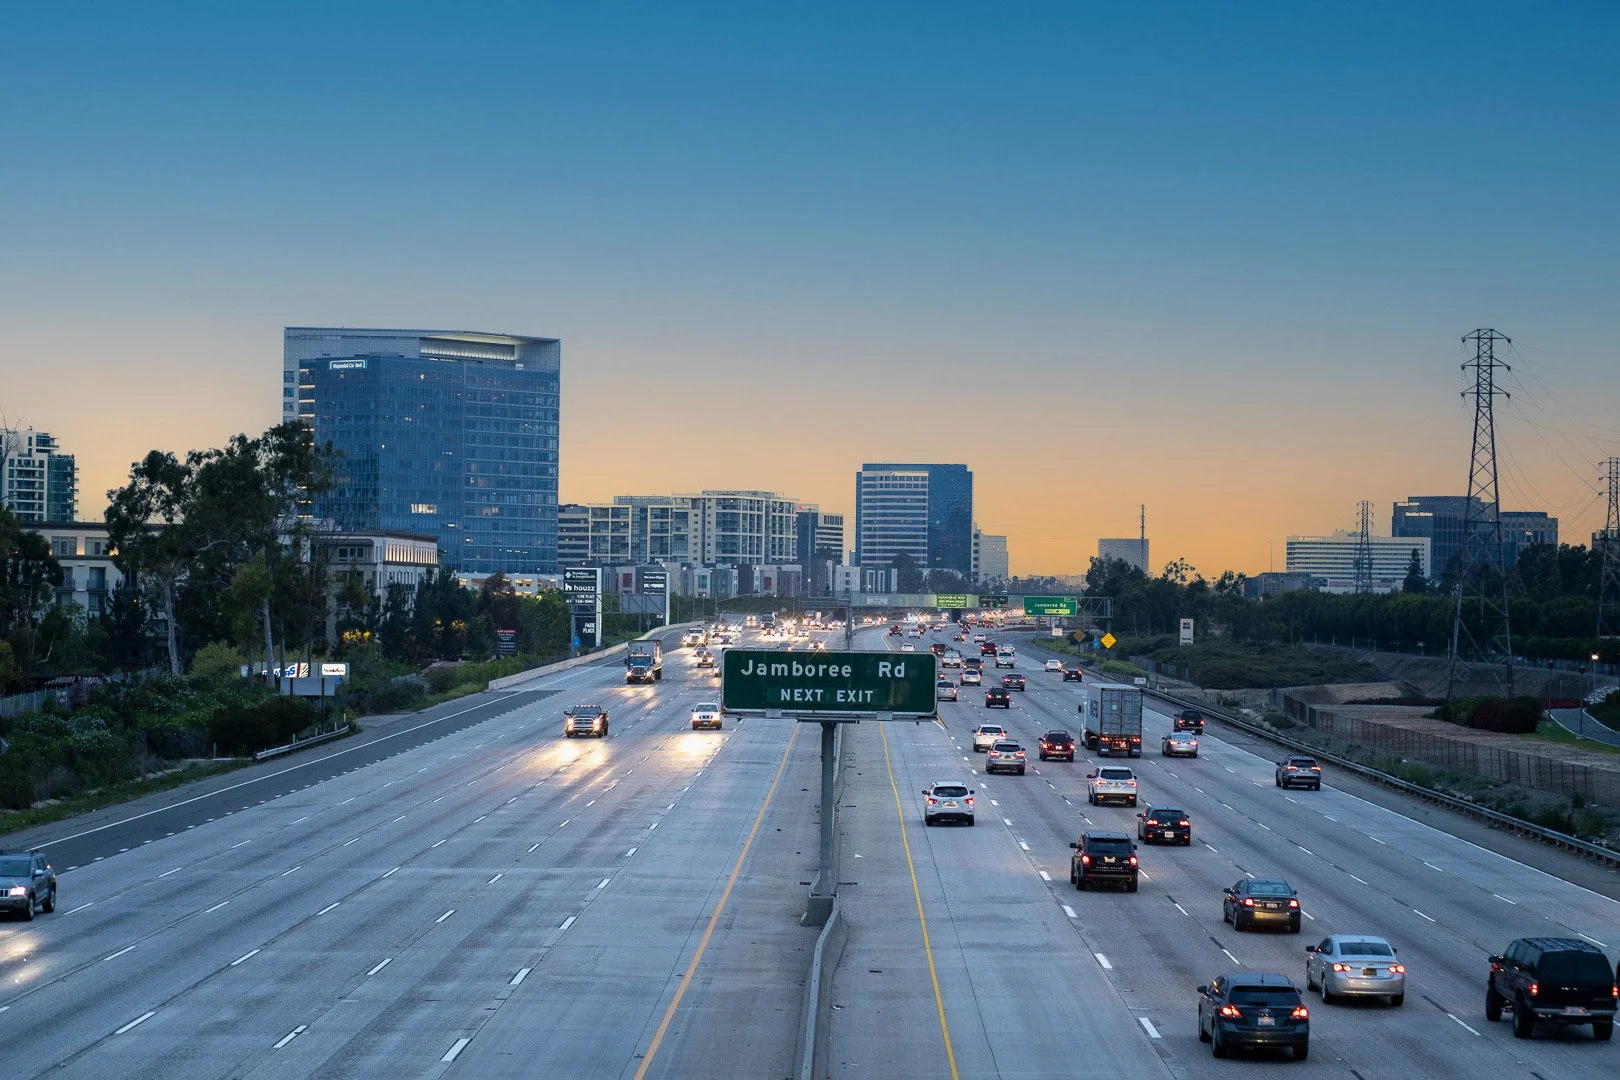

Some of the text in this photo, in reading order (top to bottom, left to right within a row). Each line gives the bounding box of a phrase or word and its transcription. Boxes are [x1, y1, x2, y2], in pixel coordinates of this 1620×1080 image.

[573, 584, 595, 592] houzz
[741, 659, 906, 679] Jamboree Rd
[780, 688, 874, 703] NEXT EXIT
